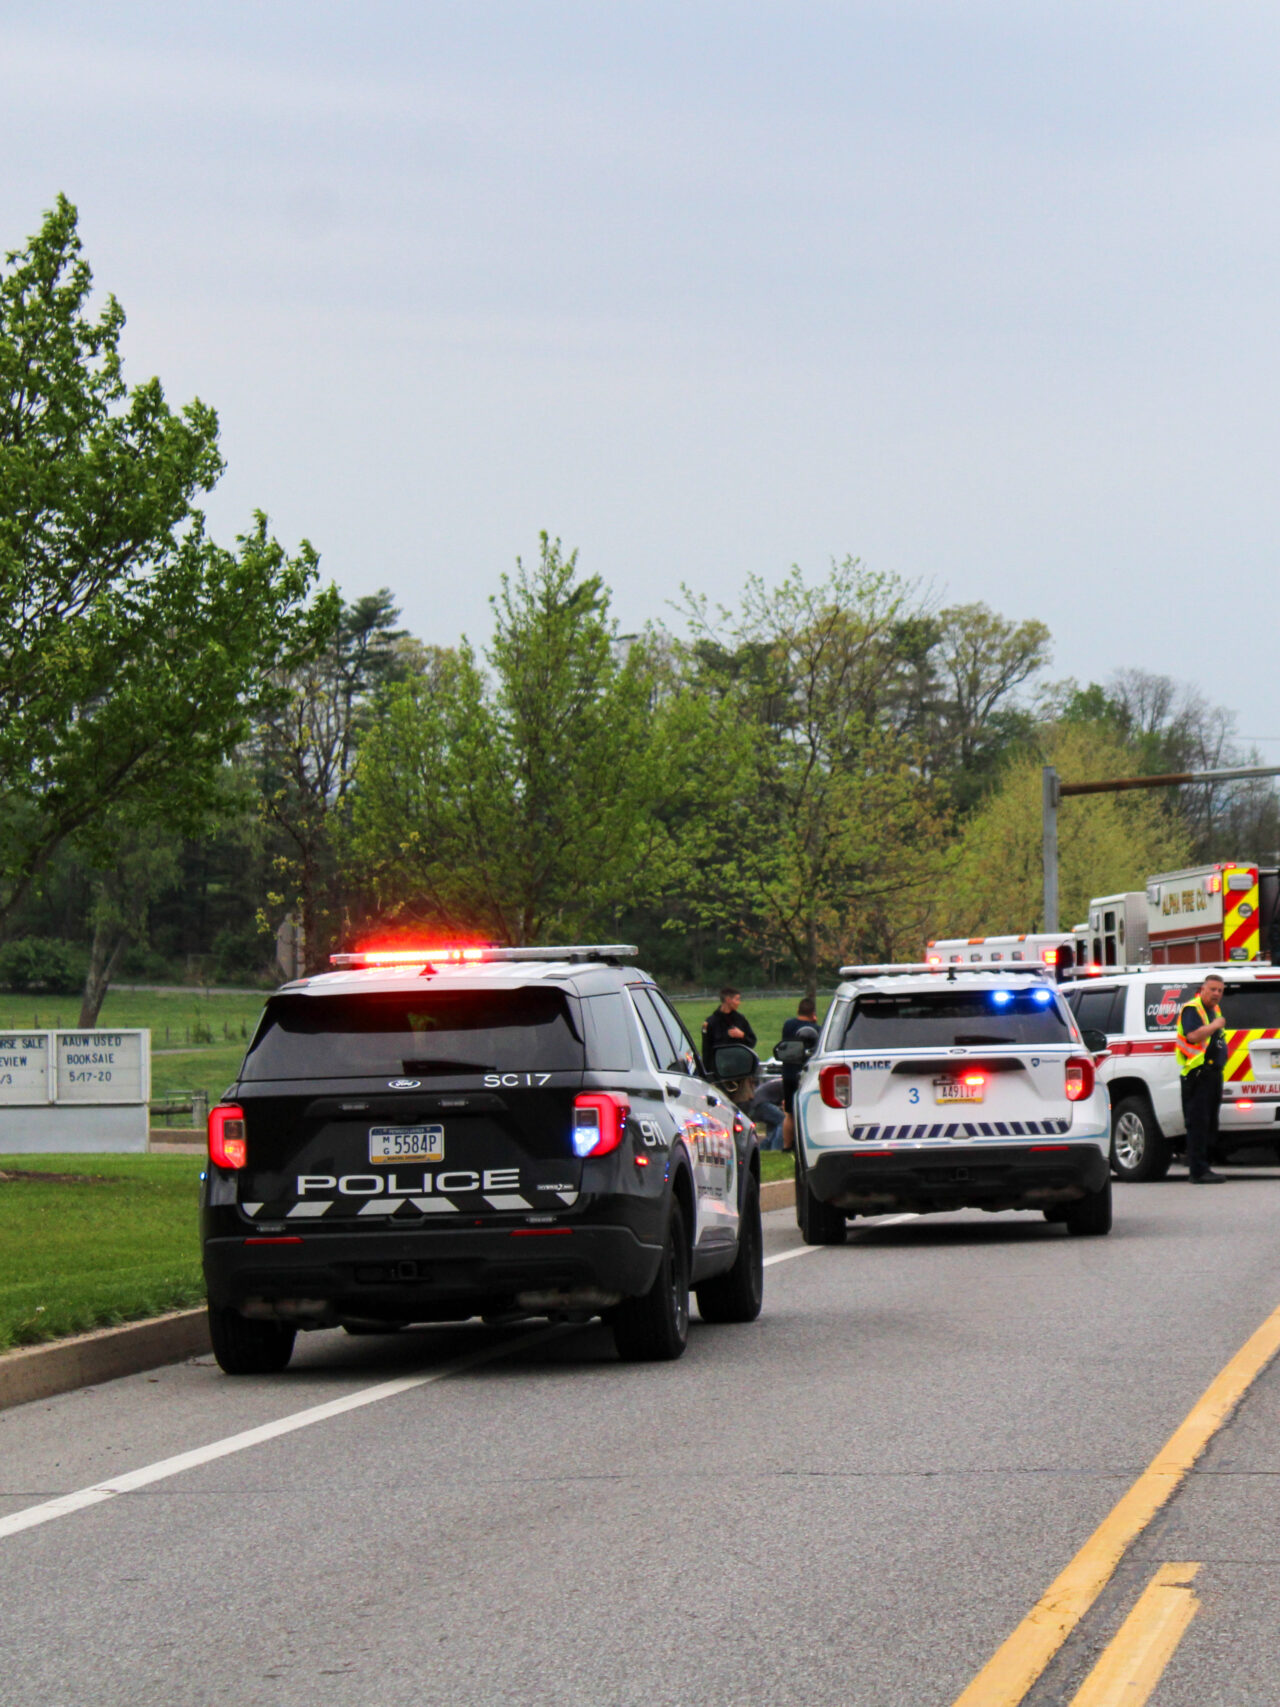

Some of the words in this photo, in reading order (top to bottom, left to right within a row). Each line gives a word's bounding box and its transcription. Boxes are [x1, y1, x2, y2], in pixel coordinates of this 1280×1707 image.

[1146, 1003, 1184, 1016] COMMAN
[1156, 989, 1182, 1026] 5
[22, 1038, 44, 1049] SALE
[62, 1036, 90, 1047] AAUW
[94, 1034, 122, 1047] USED
[852, 1060, 891, 1071] POLICE
[69, 1071, 112, 1083] 5/17-20
[908, 1087, 920, 1104] 3
[639, 1120, 667, 1147] 911
[394, 1134, 437, 1154] 5584P
[297, 1168, 520, 1196] POLICE
